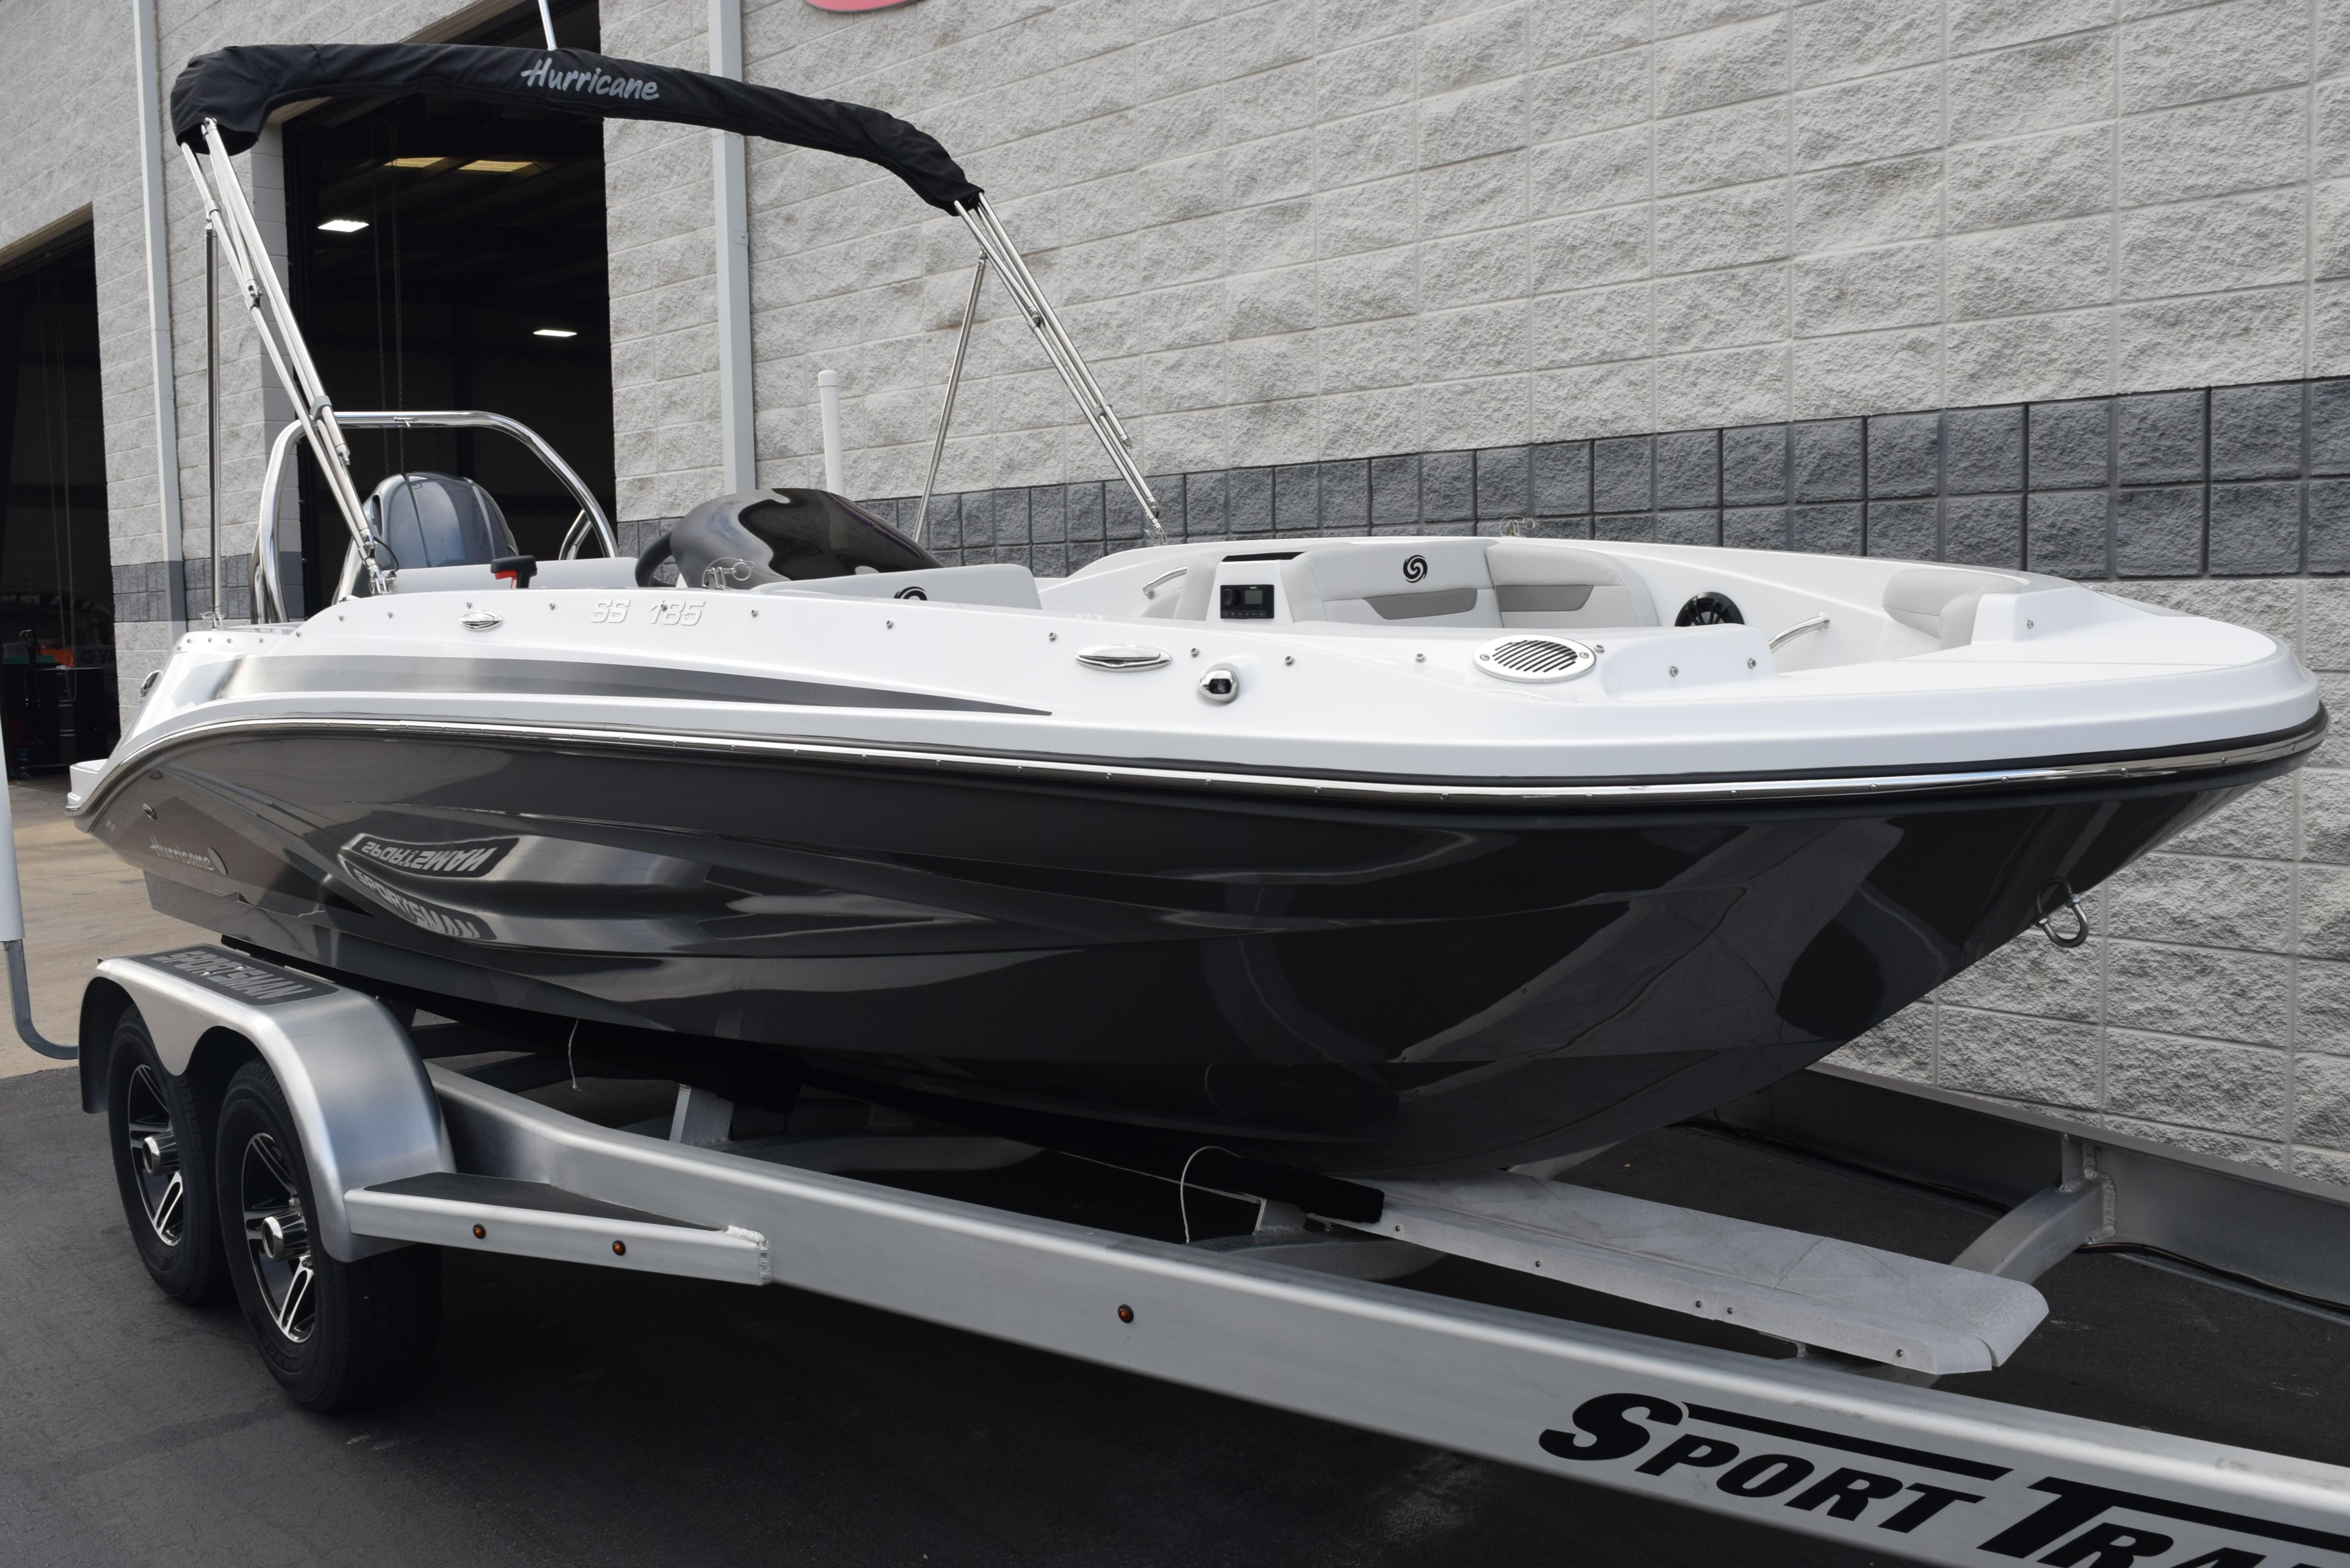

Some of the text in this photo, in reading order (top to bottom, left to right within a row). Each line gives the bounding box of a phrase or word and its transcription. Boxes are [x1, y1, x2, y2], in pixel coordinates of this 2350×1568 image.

[521, 57, 660, 100] Hurricane
[591, 599, 706, 626] SS 185
[151, 951, 313, 999] SPORTSMAN
[1538, 1393, 2350, 1568] SPORT TR
